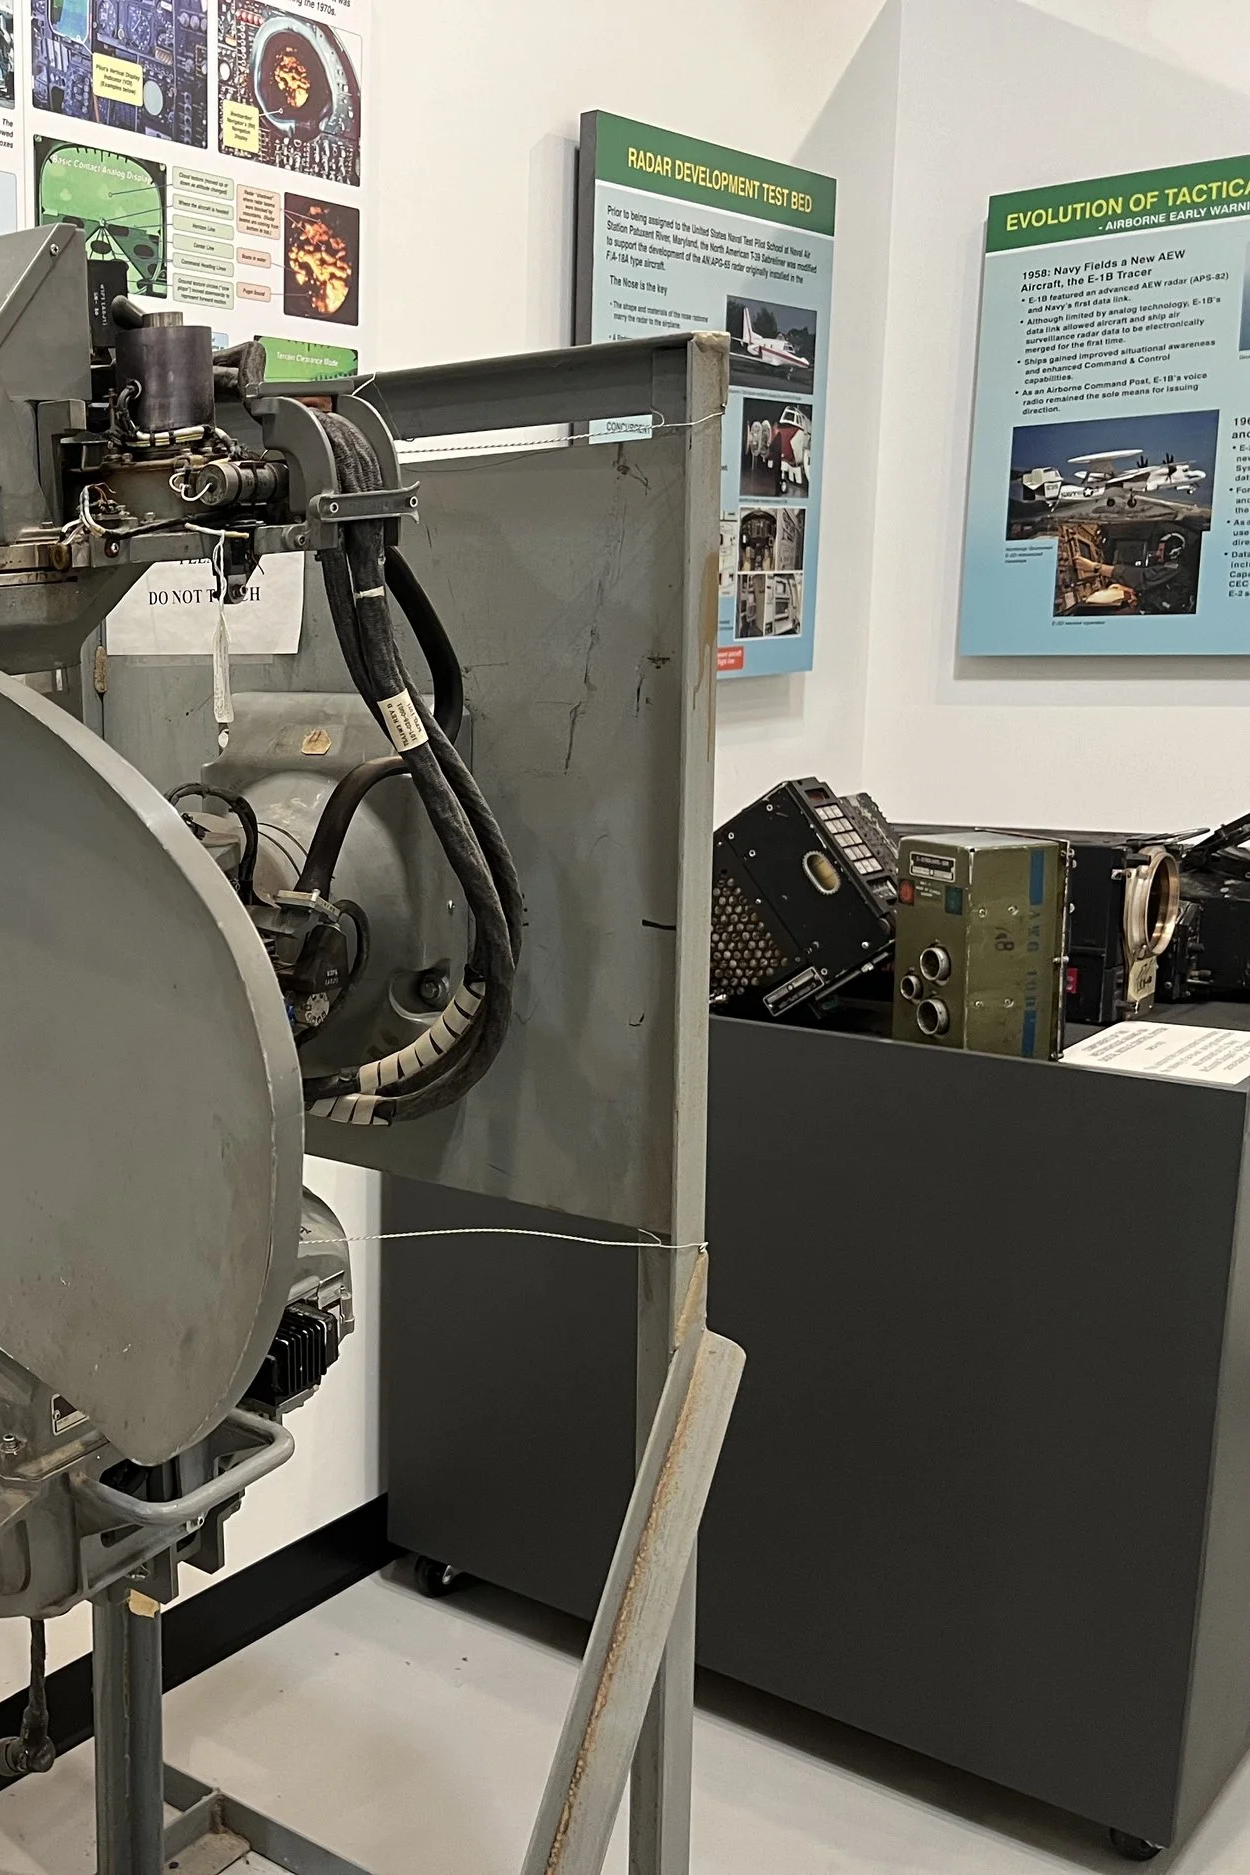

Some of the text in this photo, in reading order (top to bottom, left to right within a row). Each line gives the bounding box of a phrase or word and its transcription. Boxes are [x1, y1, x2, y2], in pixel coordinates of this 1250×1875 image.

[628, 147, 812, 212] RADAR DEVELOPMENT TEST BED
[1006, 196, 1122, 231] EVOLUTION
[1129, 191, 1159, 212] OF
[1105, 213, 1166, 230] AIRBORNE
[1169, 207, 1207, 221] EARLY
[1023, 249, 1185, 280] 1958: Navy Fields a New AEW
[609, 274, 668, 296] The Nose is the key
[1020, 268, 1152, 293] Aircraft, the E-1B Tracer
[149, 591, 169, 605] DO
[172, 589, 203, 605] NOT
